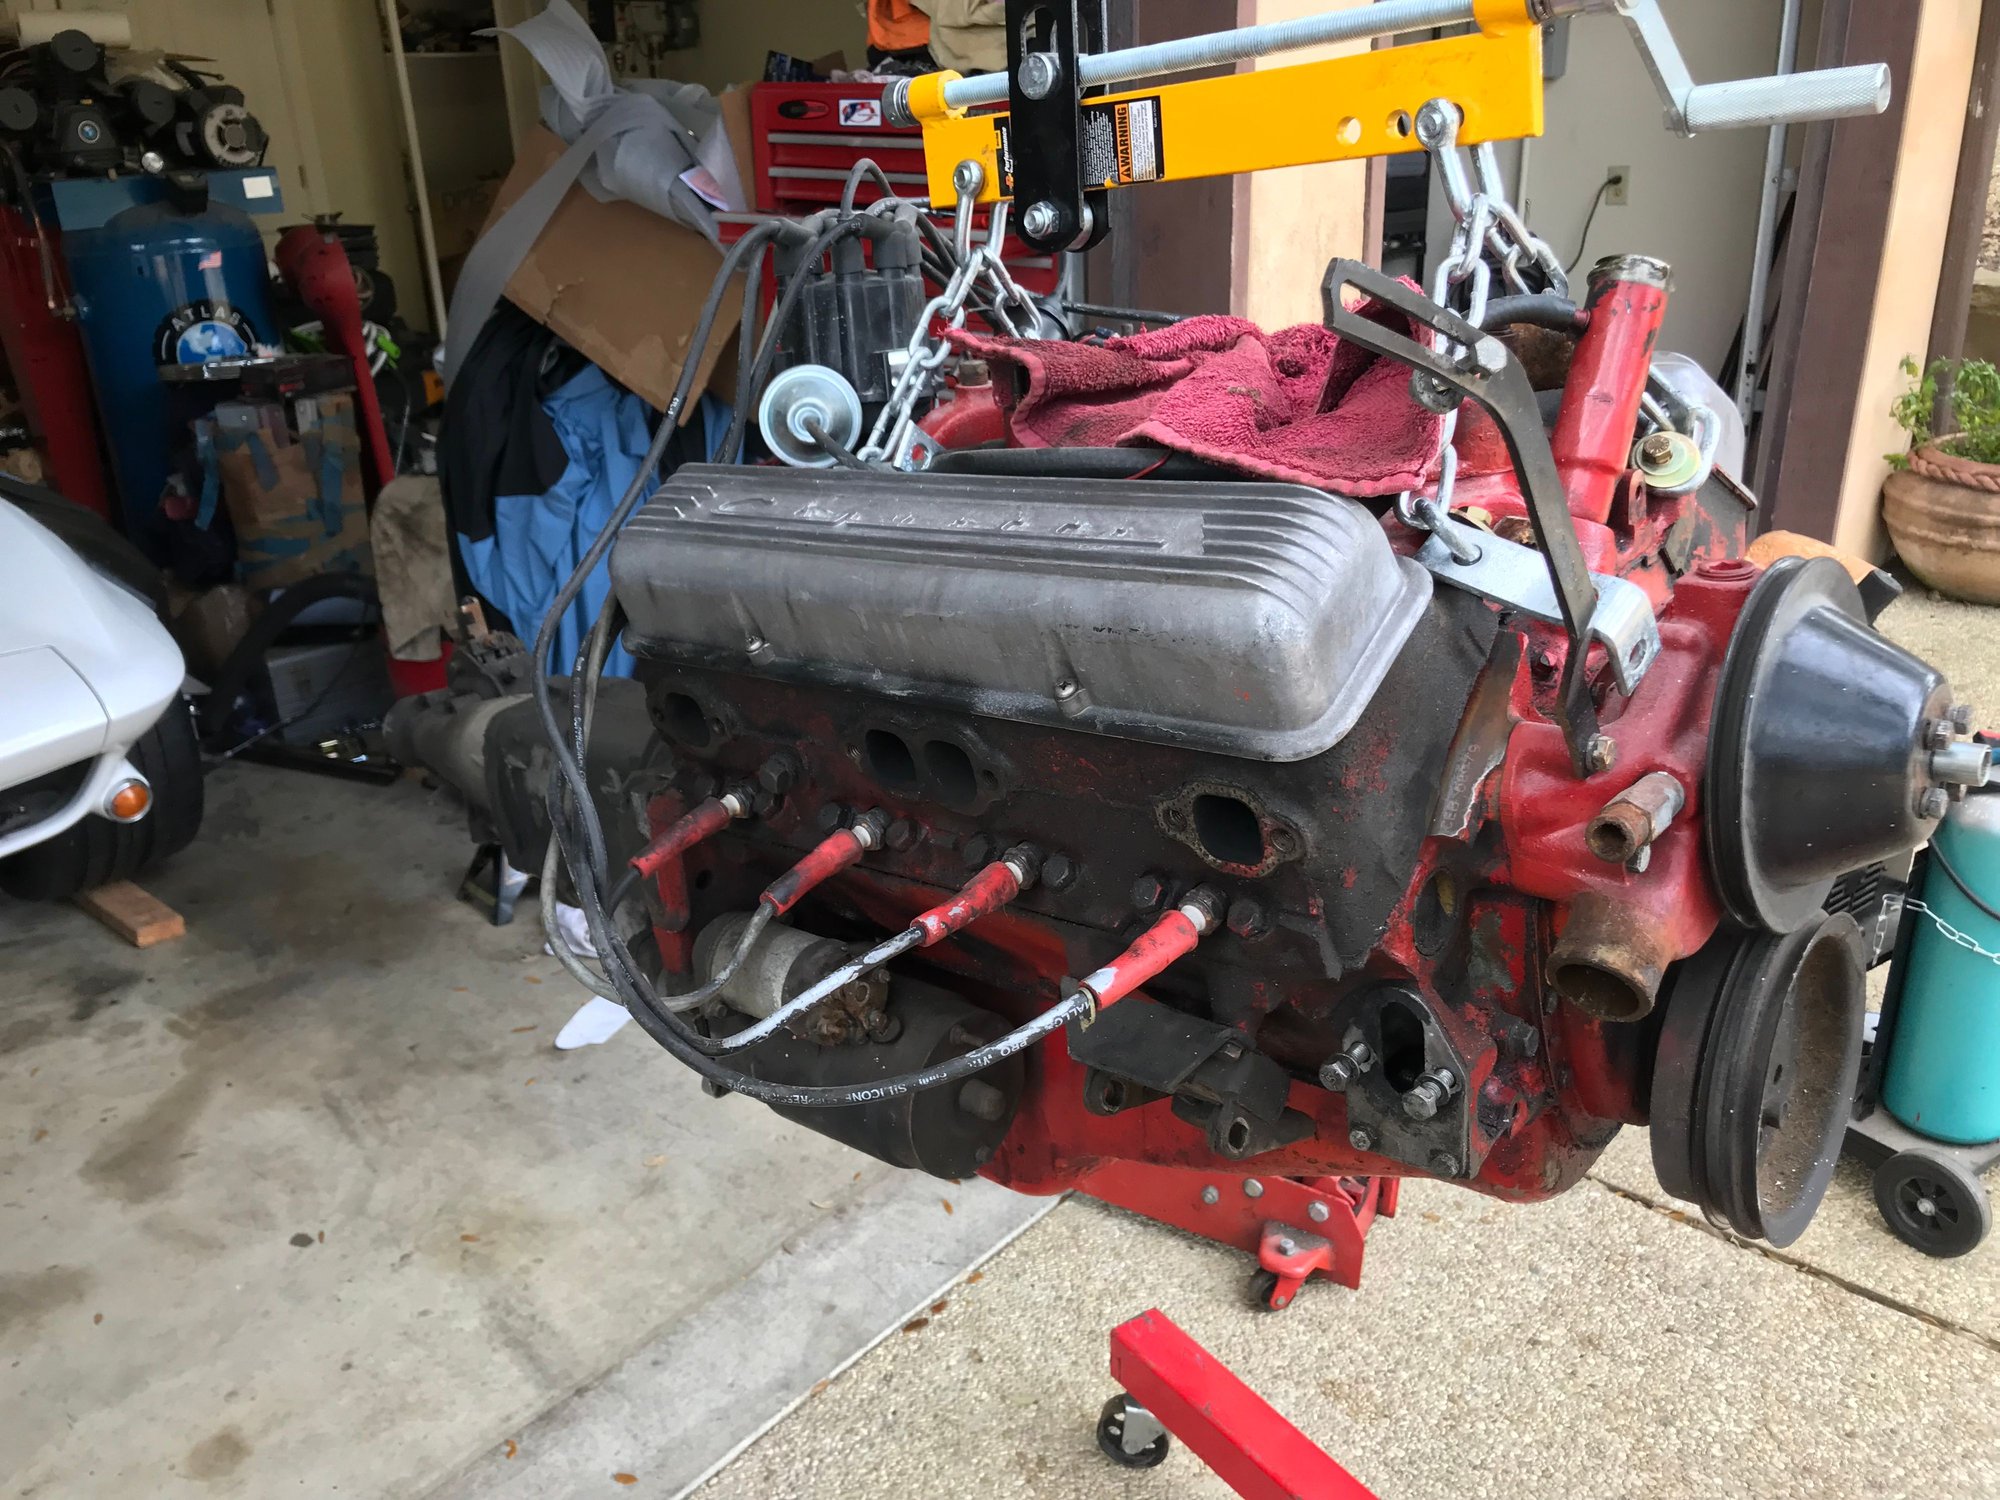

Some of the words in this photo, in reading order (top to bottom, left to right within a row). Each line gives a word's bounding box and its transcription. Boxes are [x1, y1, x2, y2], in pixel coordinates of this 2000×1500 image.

[1117, 107, 1131, 168] WARNING
[172, 306, 241, 331] ATLAS
[1000, 1039, 1028, 1057] PRO
